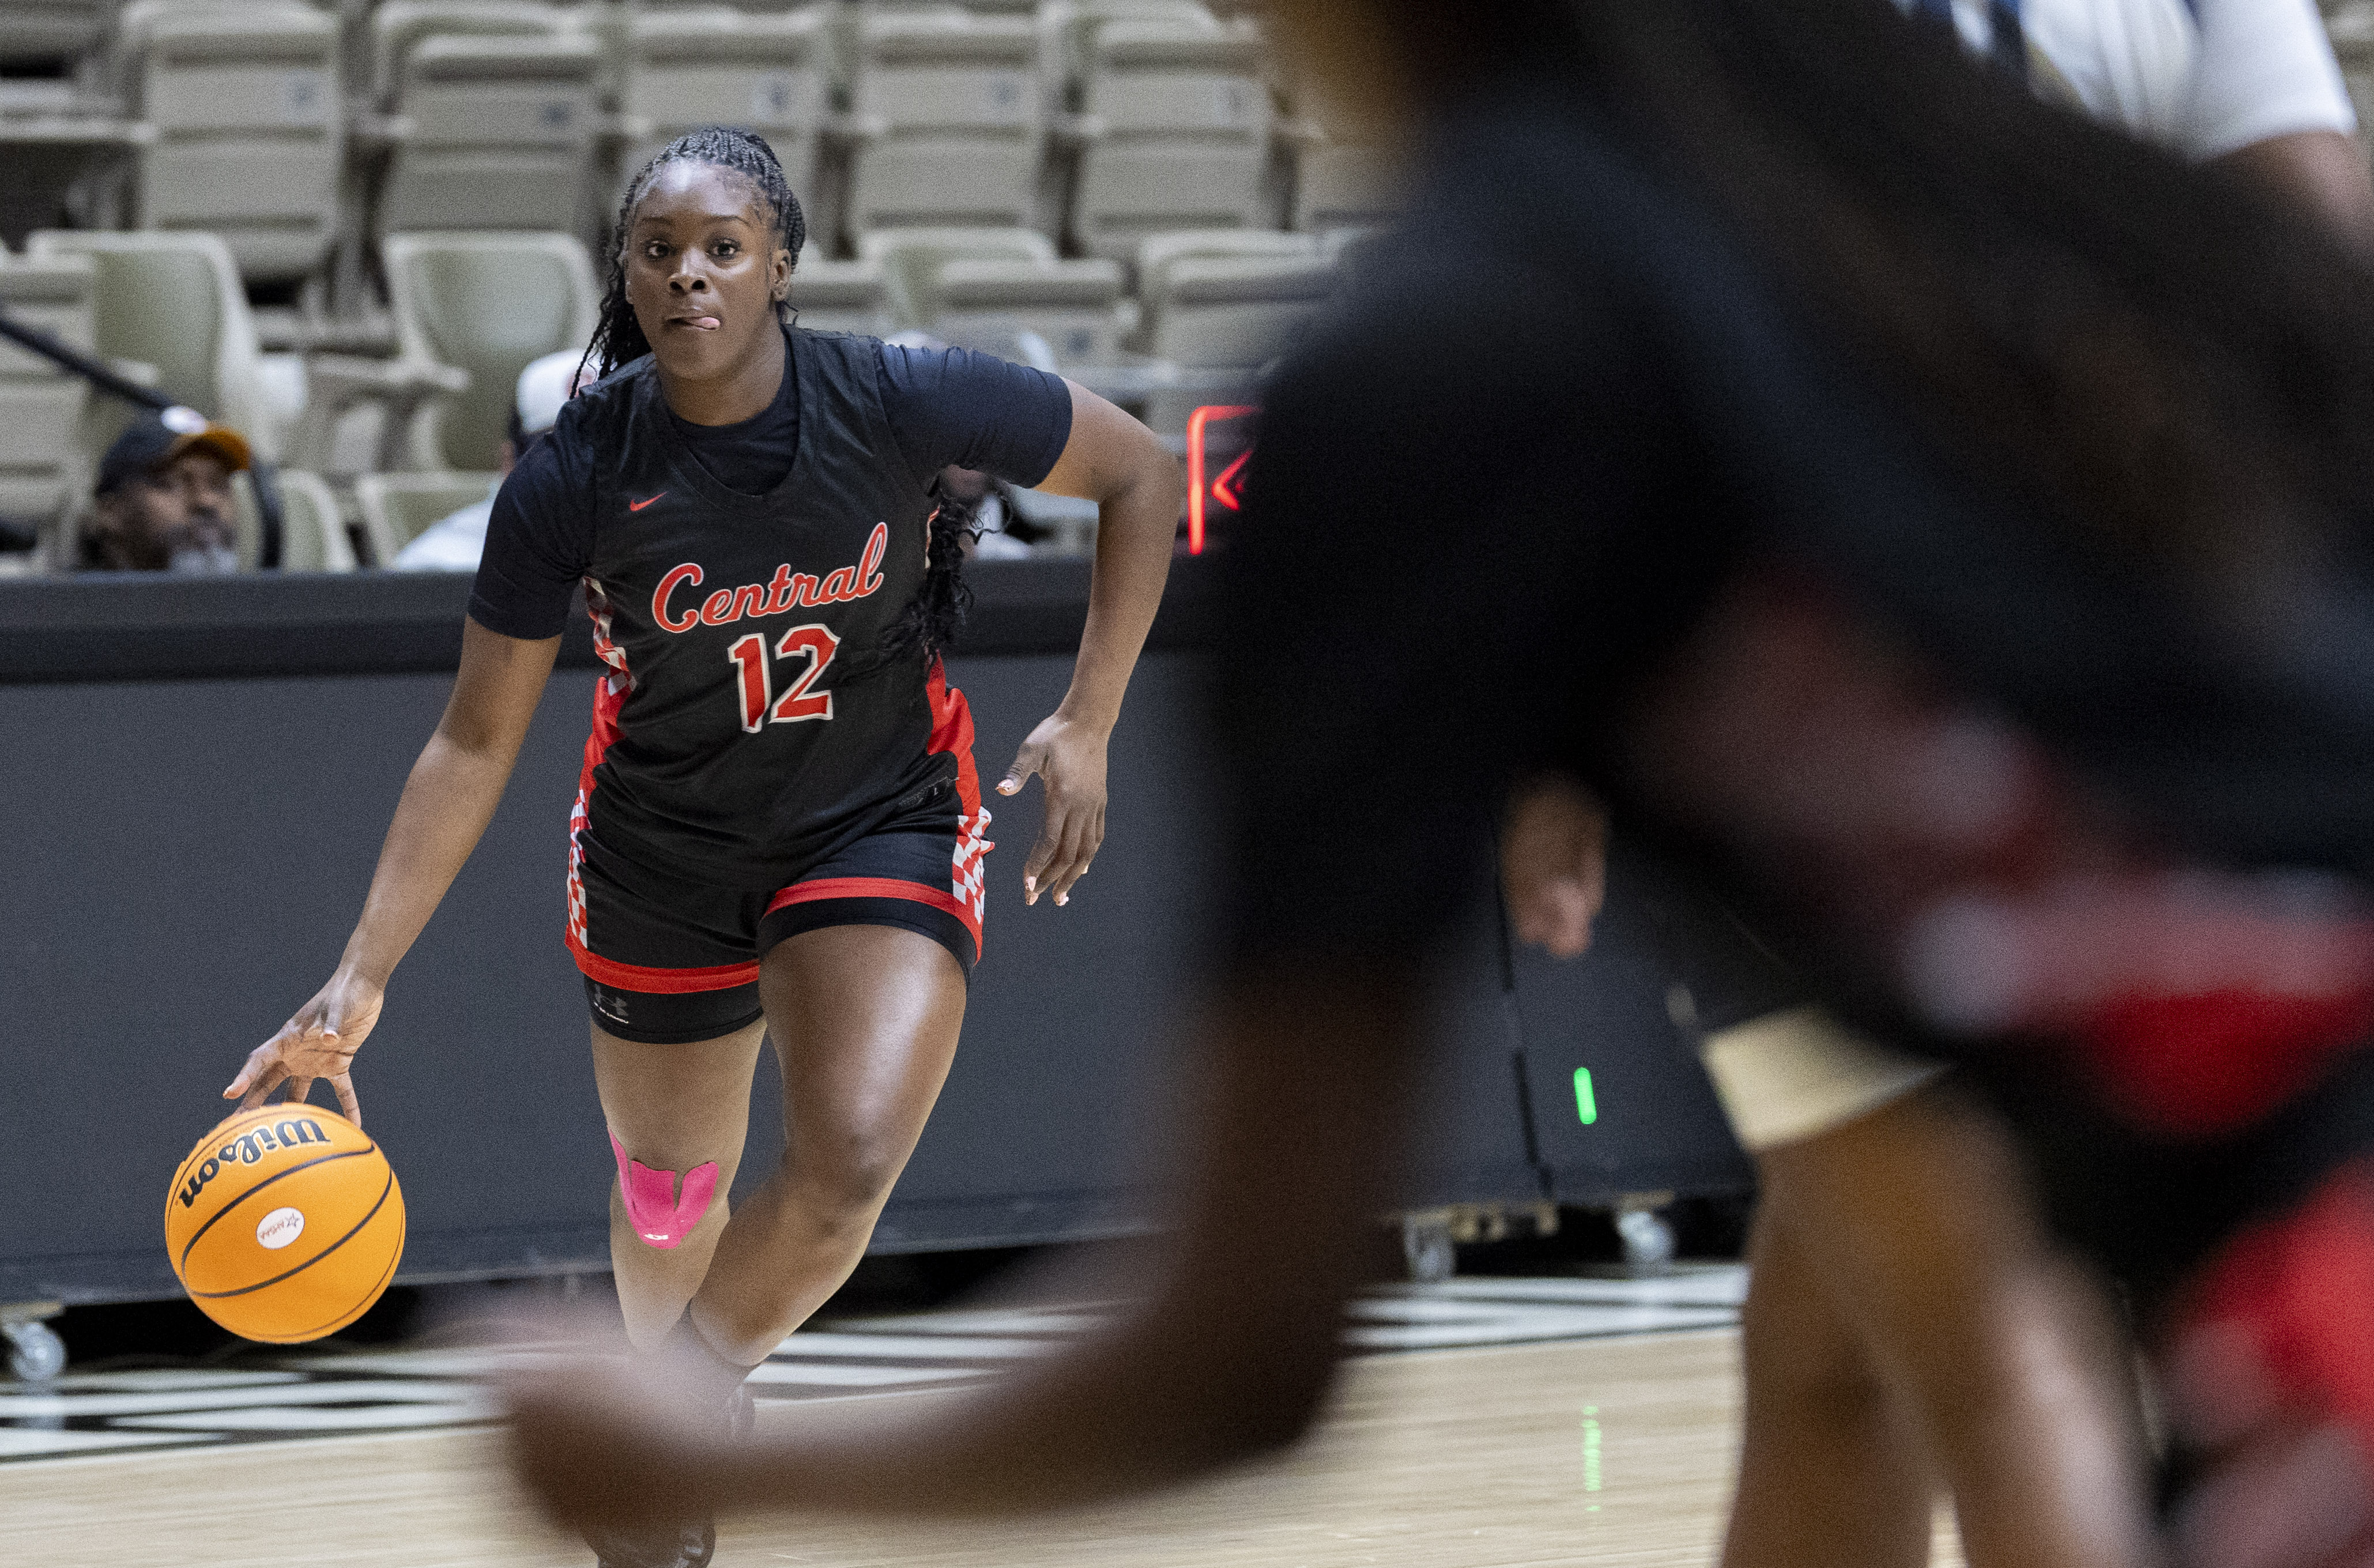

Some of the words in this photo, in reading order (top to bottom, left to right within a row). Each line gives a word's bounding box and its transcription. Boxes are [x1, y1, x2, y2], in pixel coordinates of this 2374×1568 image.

[652, 522, 888, 634] Central
[727, 624, 841, 733] 12
[179, 1118, 332, 1208] Wilson
